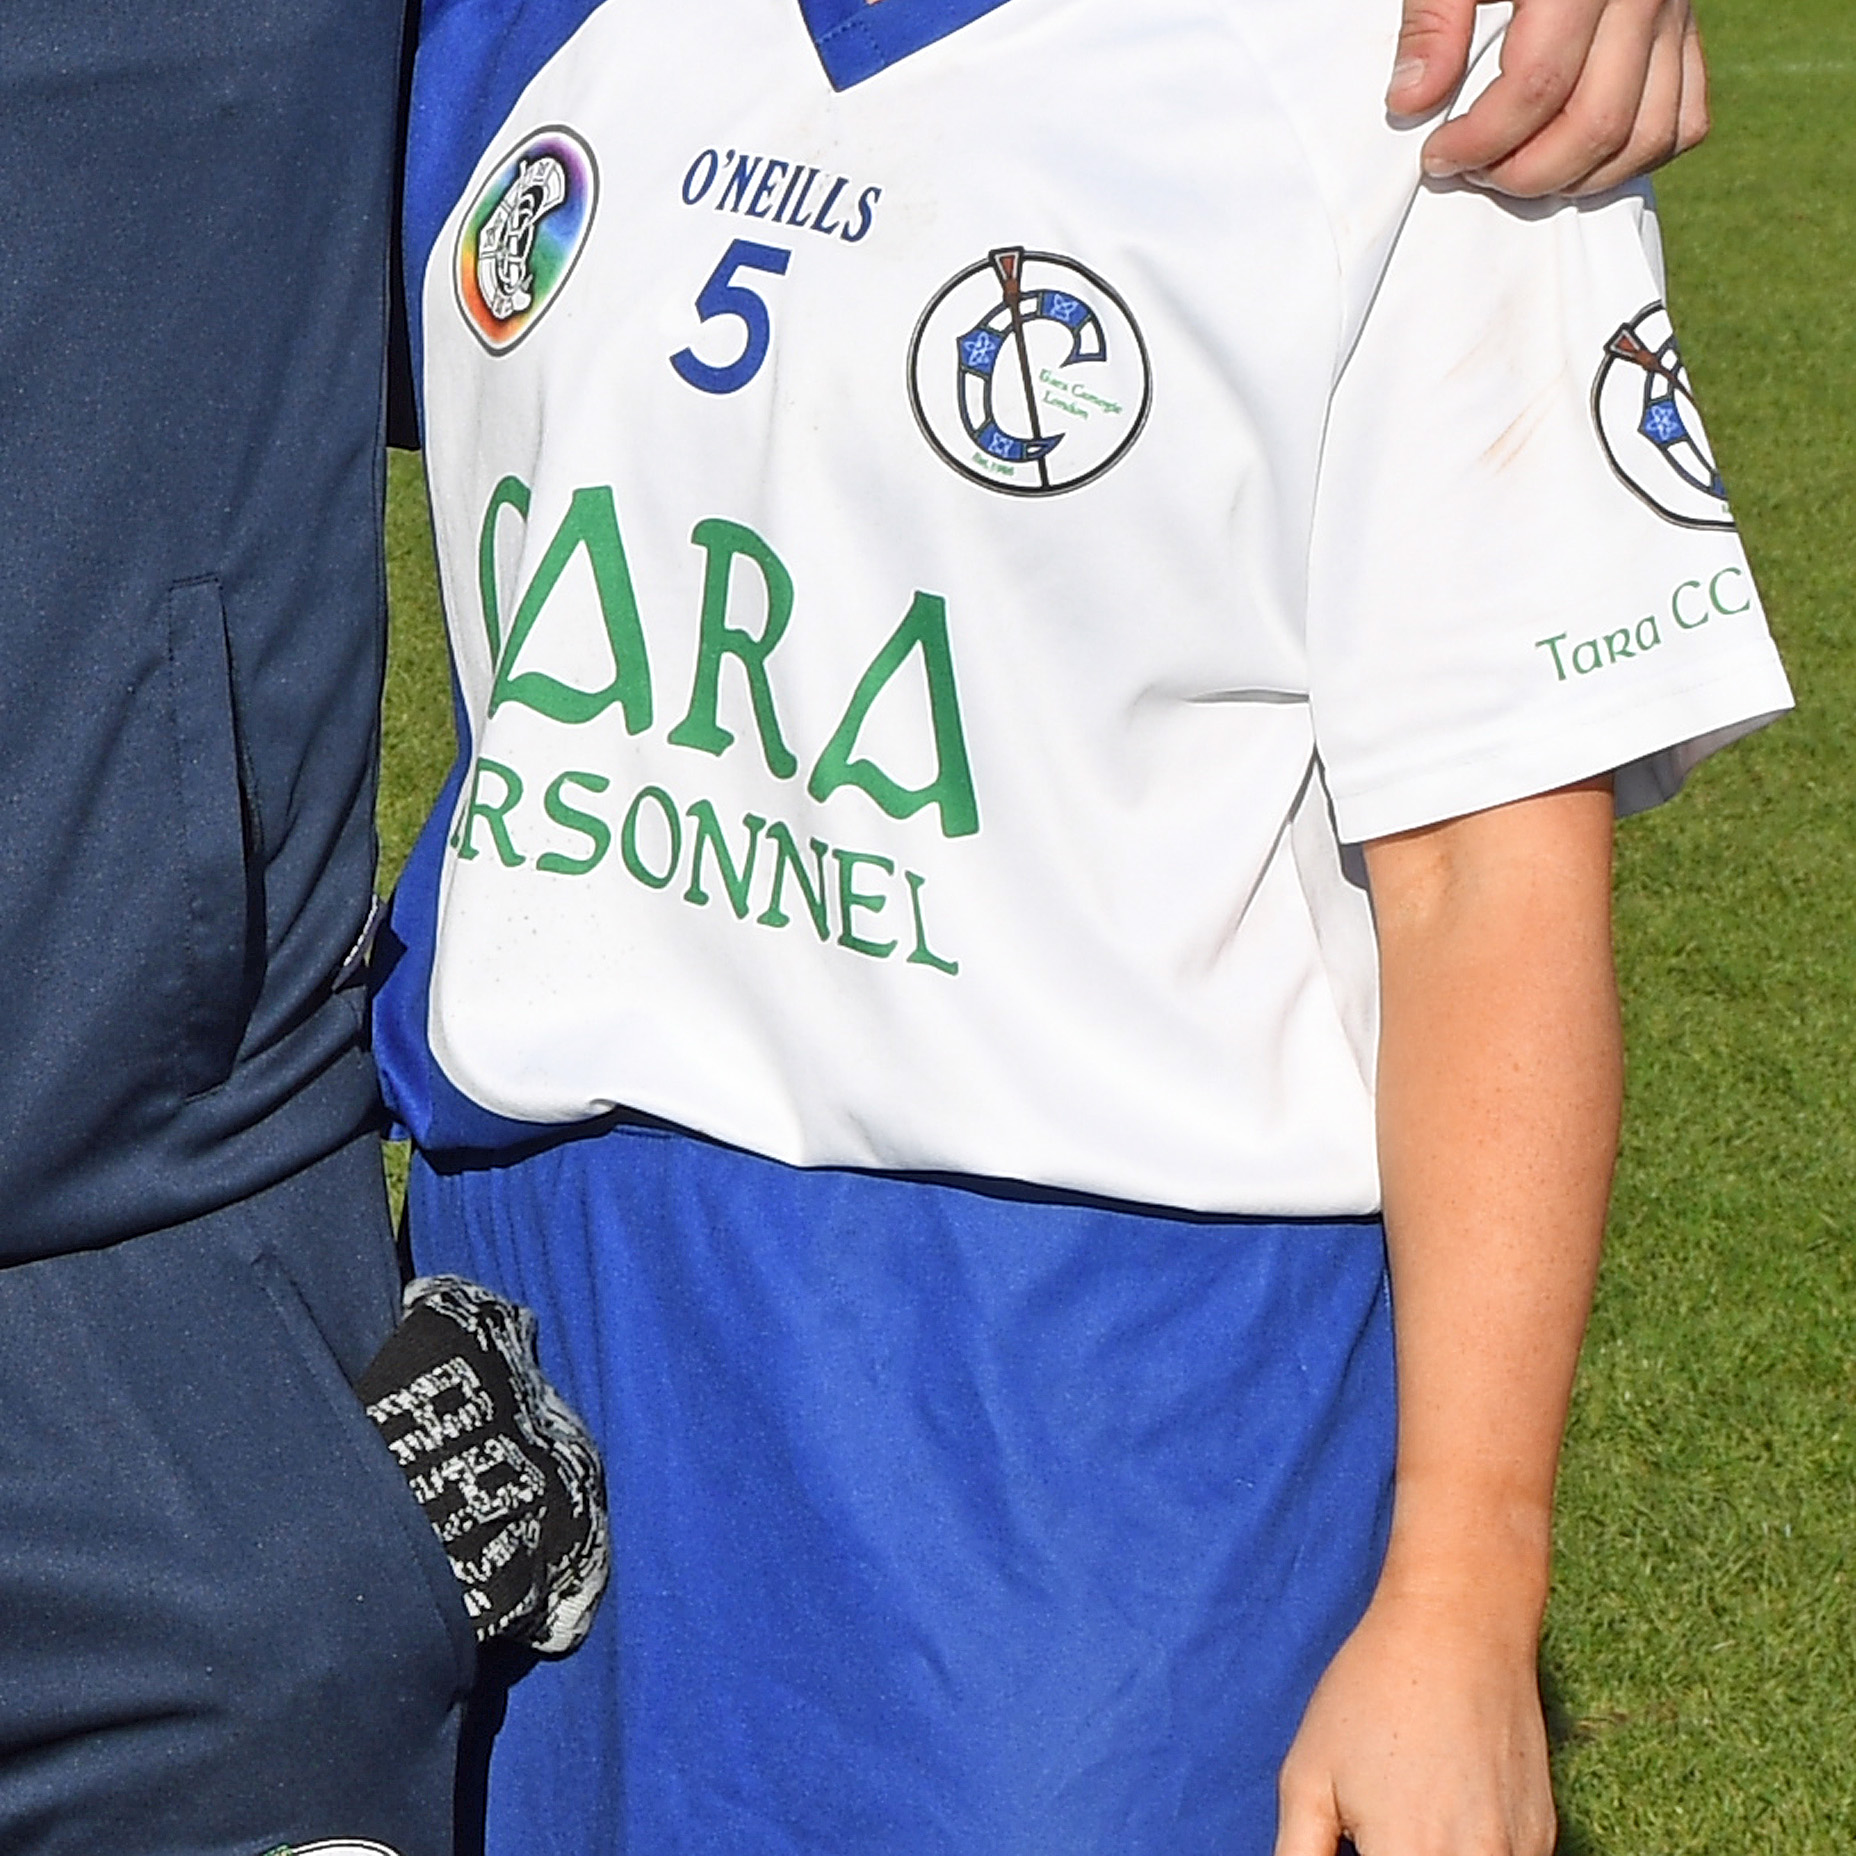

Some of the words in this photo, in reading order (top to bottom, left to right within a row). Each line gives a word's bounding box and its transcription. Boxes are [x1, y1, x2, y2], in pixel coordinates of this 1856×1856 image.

[683, 149, 882, 243] O'NEILLS
[673, 239, 792, 394] 5
[1535, 616, 1662, 682] Tara
[1671, 566, 1751, 629] CC
[451, 756, 959, 976] RSONNEL
